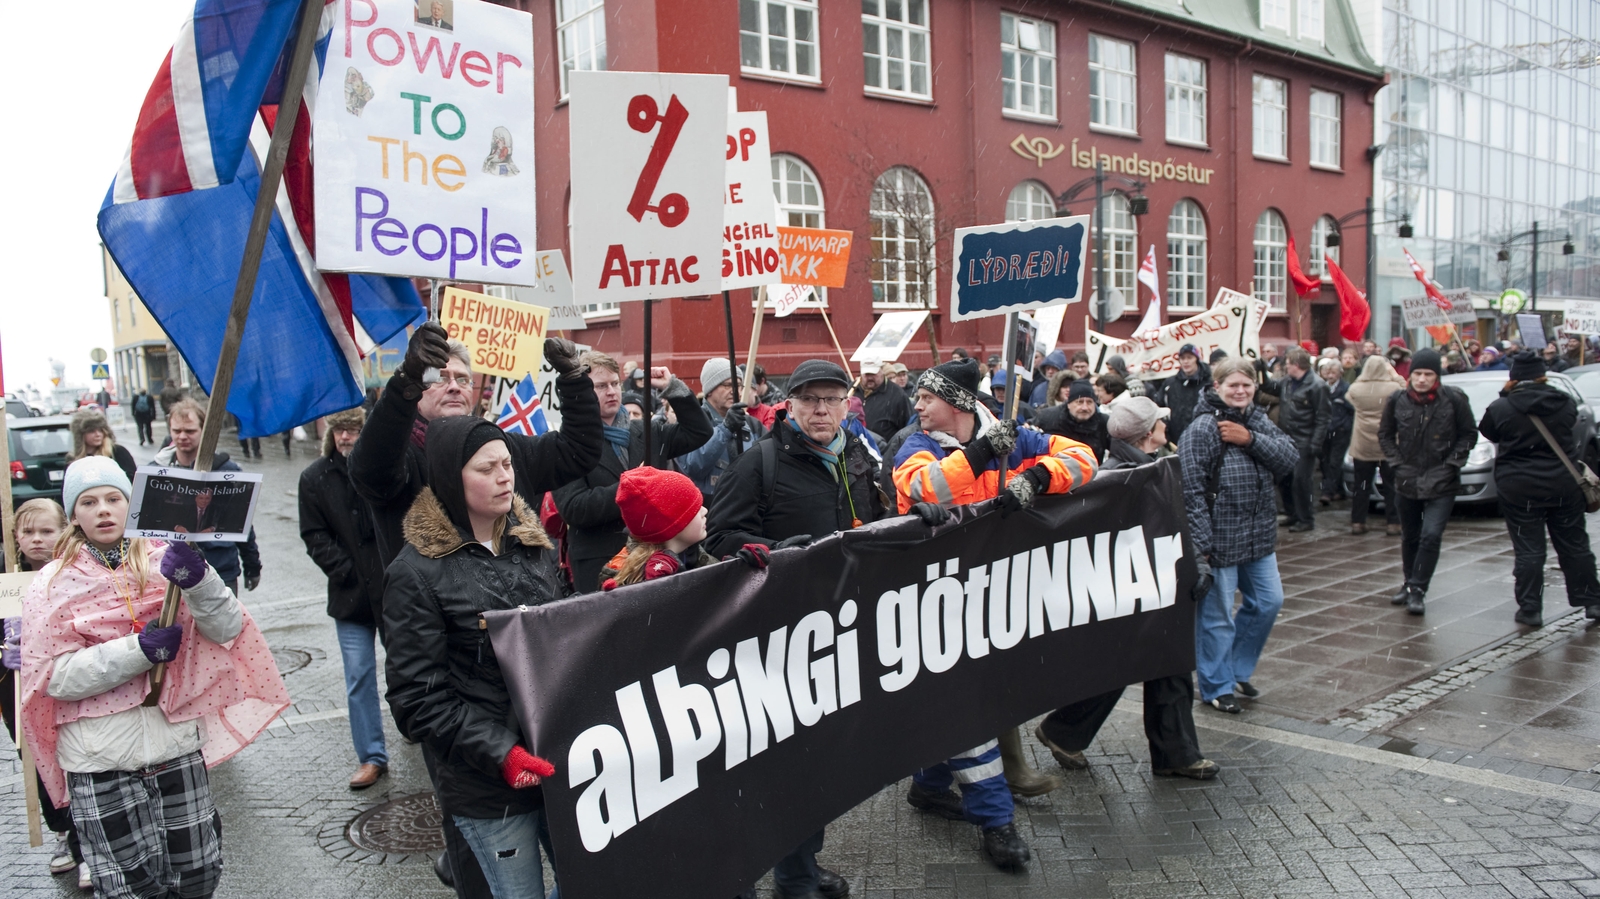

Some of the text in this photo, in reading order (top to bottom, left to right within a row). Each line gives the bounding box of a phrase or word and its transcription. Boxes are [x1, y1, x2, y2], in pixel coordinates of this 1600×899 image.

[344, 0, 523, 94] Power
[367, 135, 467, 192] The
[1071, 138, 1214, 185] Íslandspóstur
[355, 186, 523, 279] People
[721, 243, 779, 278] SINO
[779, 253, 824, 279] AKK
[448, 295, 543, 338] HEIMURINN
[1169, 314, 1229, 341] WORLD
[446, 322, 517, 350] er ekki
[475, 347, 516, 372] SÖLU
[150, 479, 247, 497] Guð blessi Ísland
